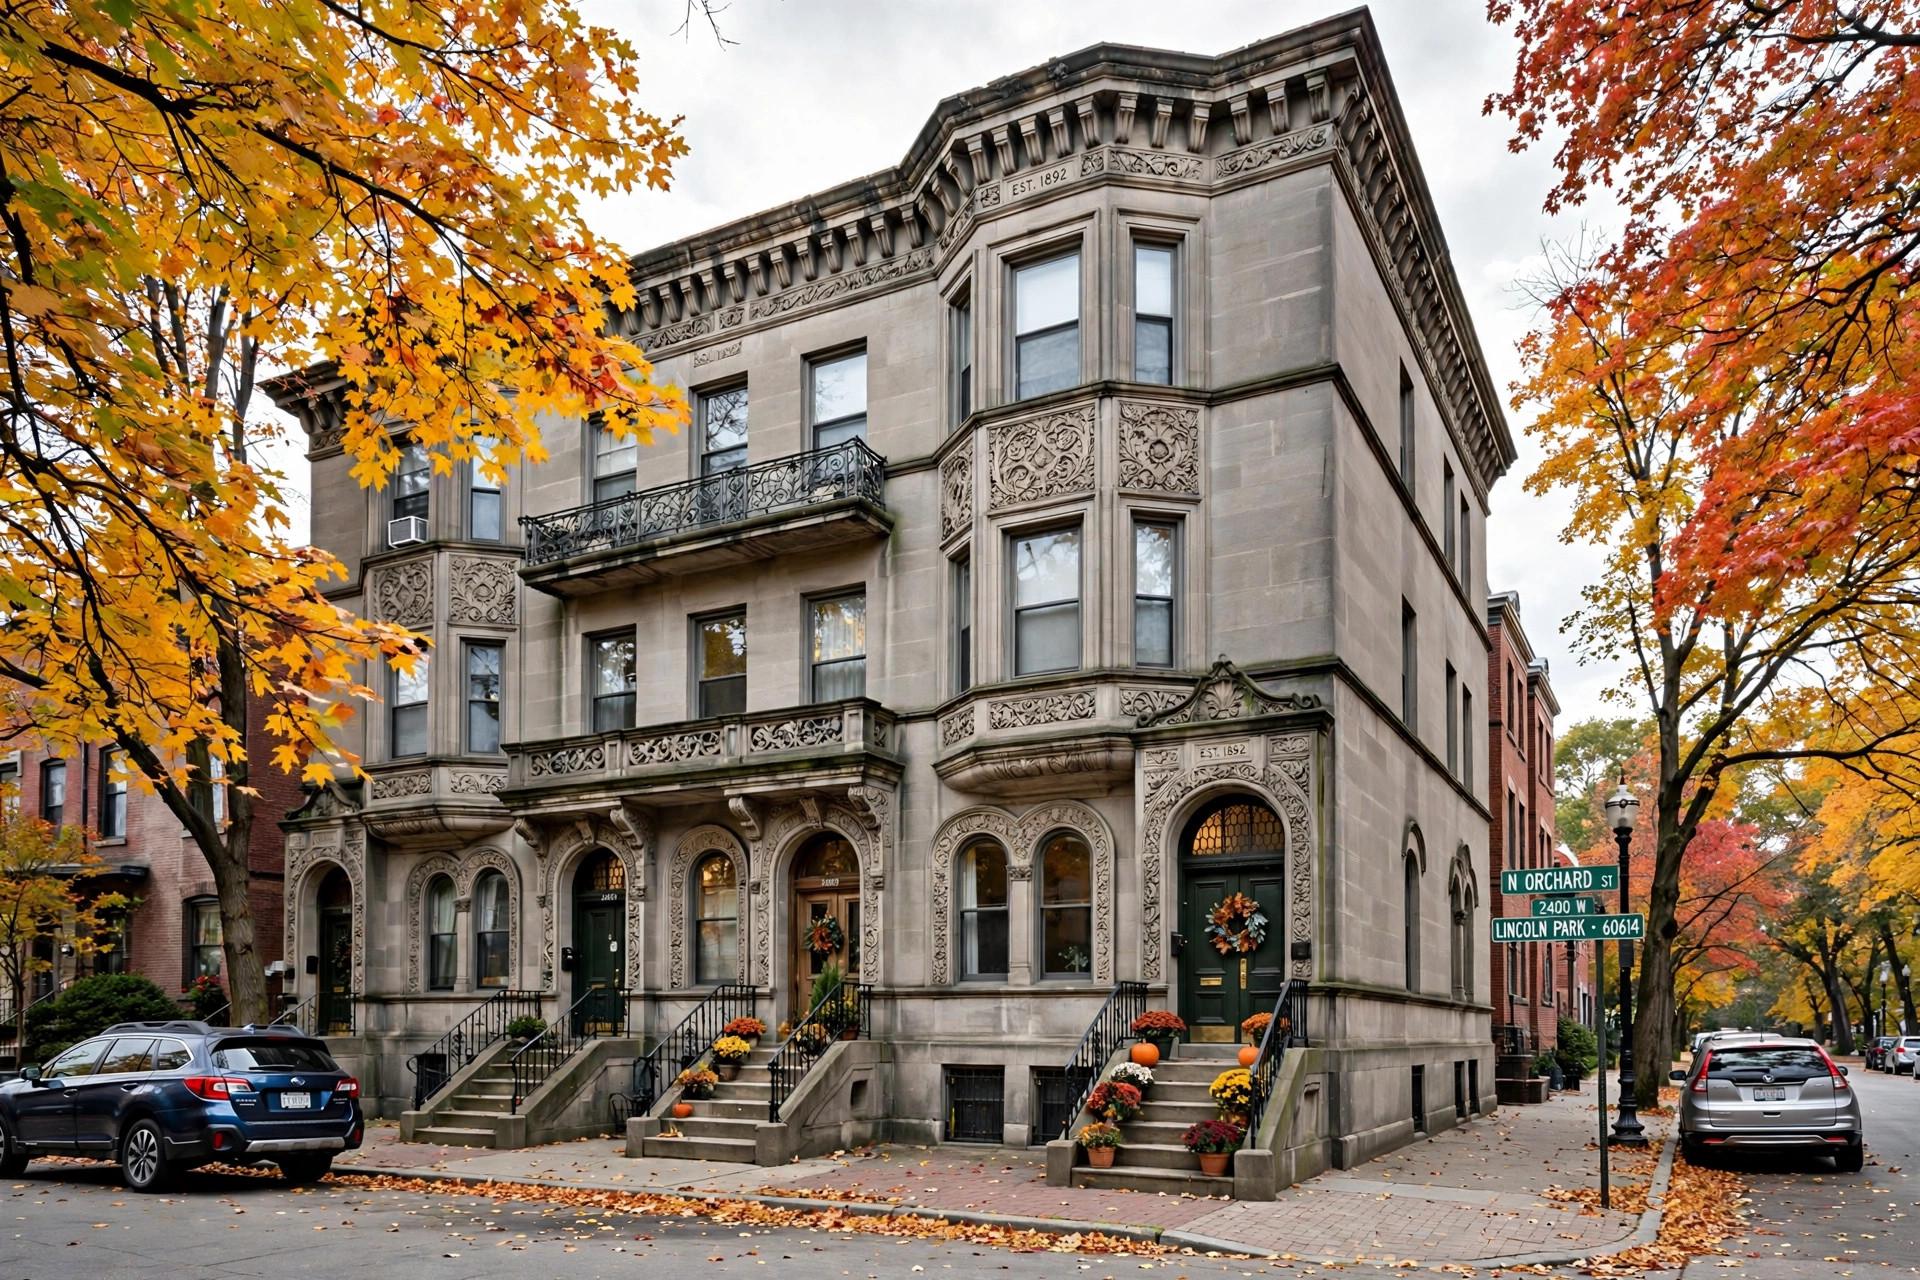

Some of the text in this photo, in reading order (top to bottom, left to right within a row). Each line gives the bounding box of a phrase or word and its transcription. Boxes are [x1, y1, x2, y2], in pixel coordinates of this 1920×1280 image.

[1012, 168, 1067, 196] EST. 1892
[1508, 870, 1613, 891] N ORCHARD ST
[1539, 899, 1586, 915] 2400 W
[1496, 918, 1639, 938] LINCOLN PARK 60614
